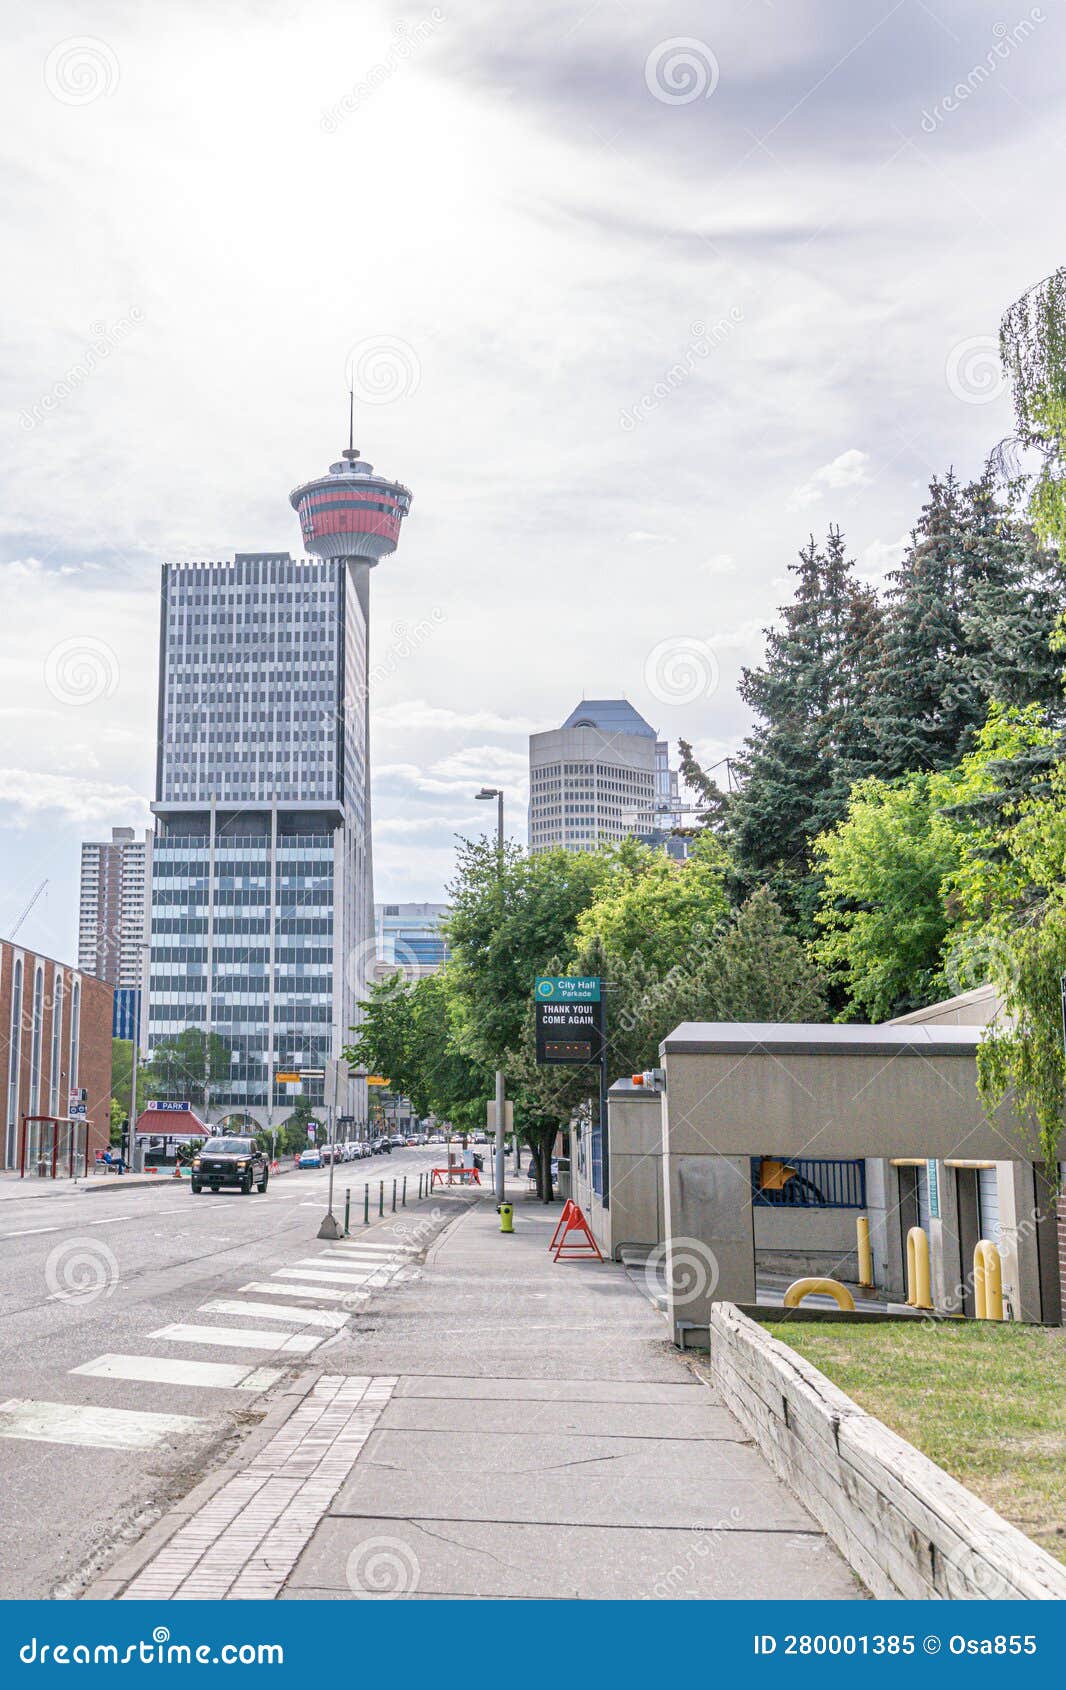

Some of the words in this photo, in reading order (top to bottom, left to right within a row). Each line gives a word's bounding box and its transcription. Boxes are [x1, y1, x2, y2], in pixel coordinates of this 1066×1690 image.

[558, 981, 576, 990] City
[577, 981, 596, 989] Hall
[543, 1005, 570, 1014] THANK
[573, 1005, 593, 1014] YOU!
[542, 1015, 566, 1024] COME
[568, 1016, 594, 1025] AGAIN
[162, 1102, 184, 1110] PARK
